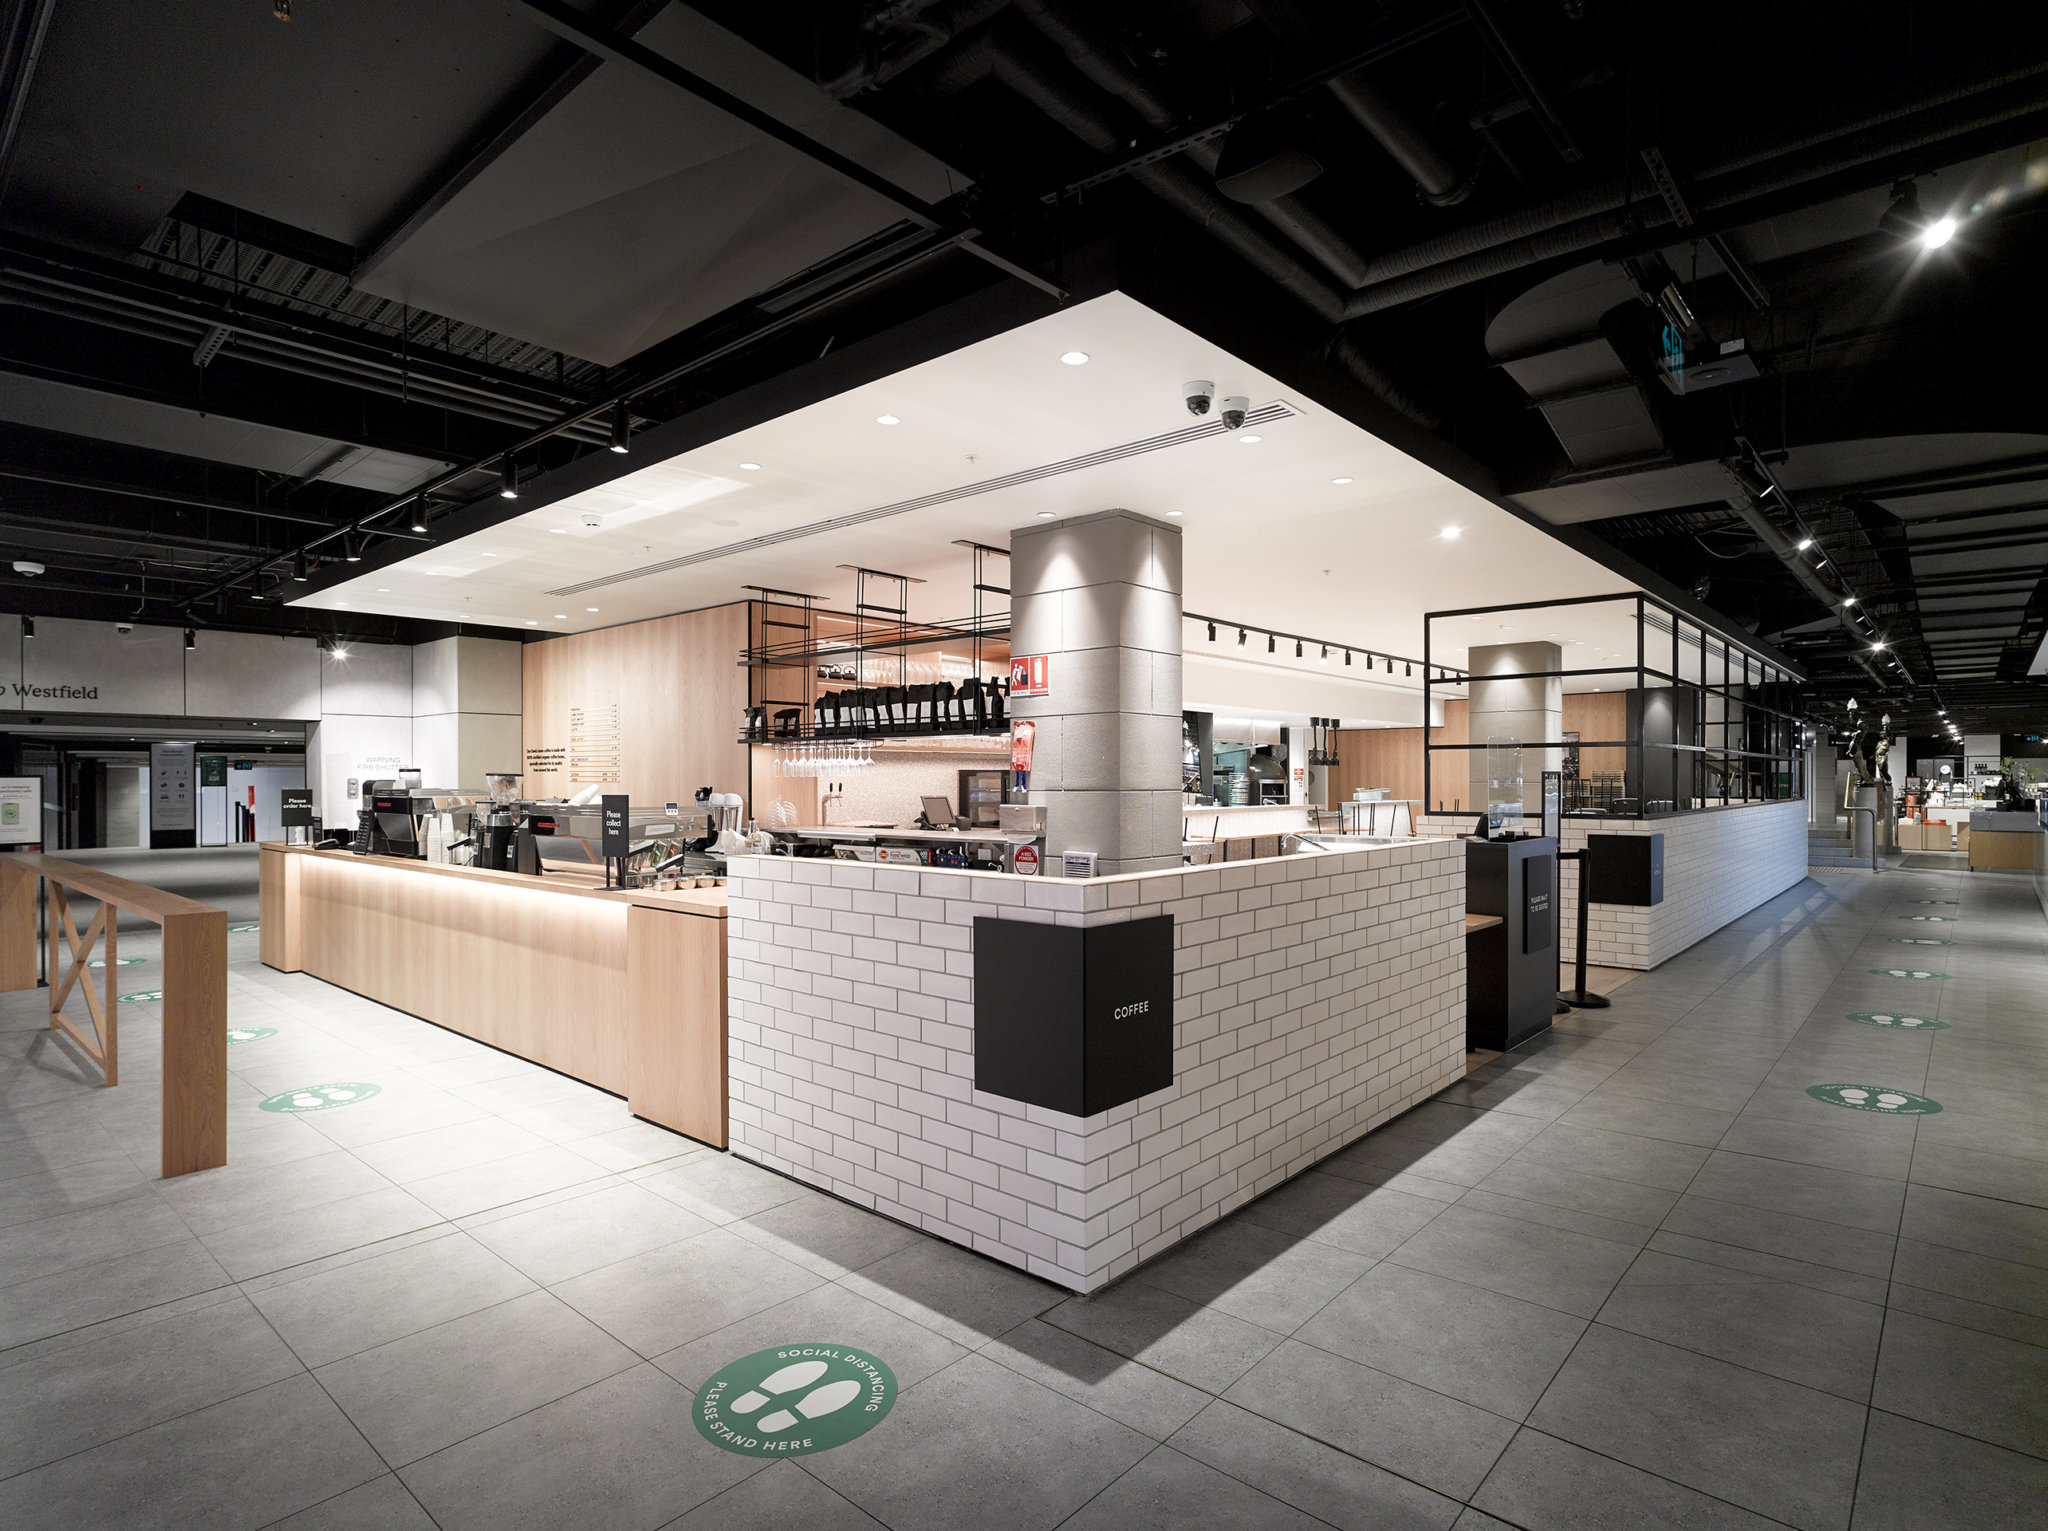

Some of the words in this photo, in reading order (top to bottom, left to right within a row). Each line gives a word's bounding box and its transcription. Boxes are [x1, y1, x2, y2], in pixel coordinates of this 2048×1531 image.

[12, 683, 98, 700] Westfield
[606, 810, 621, 818] Please
[606, 819, 621, 827] collect
[608, 827, 619, 835] here
[1114, 1001, 1149, 1020] COFFEE
[777, 1348, 840, 1360] SOCIAL
[843, 1353, 886, 1413] DISTANCING
[703, 1380, 728, 1422] PLEASE
[709, 1420, 758, 1449] STAND
[763, 1437, 813, 1451] HERE
